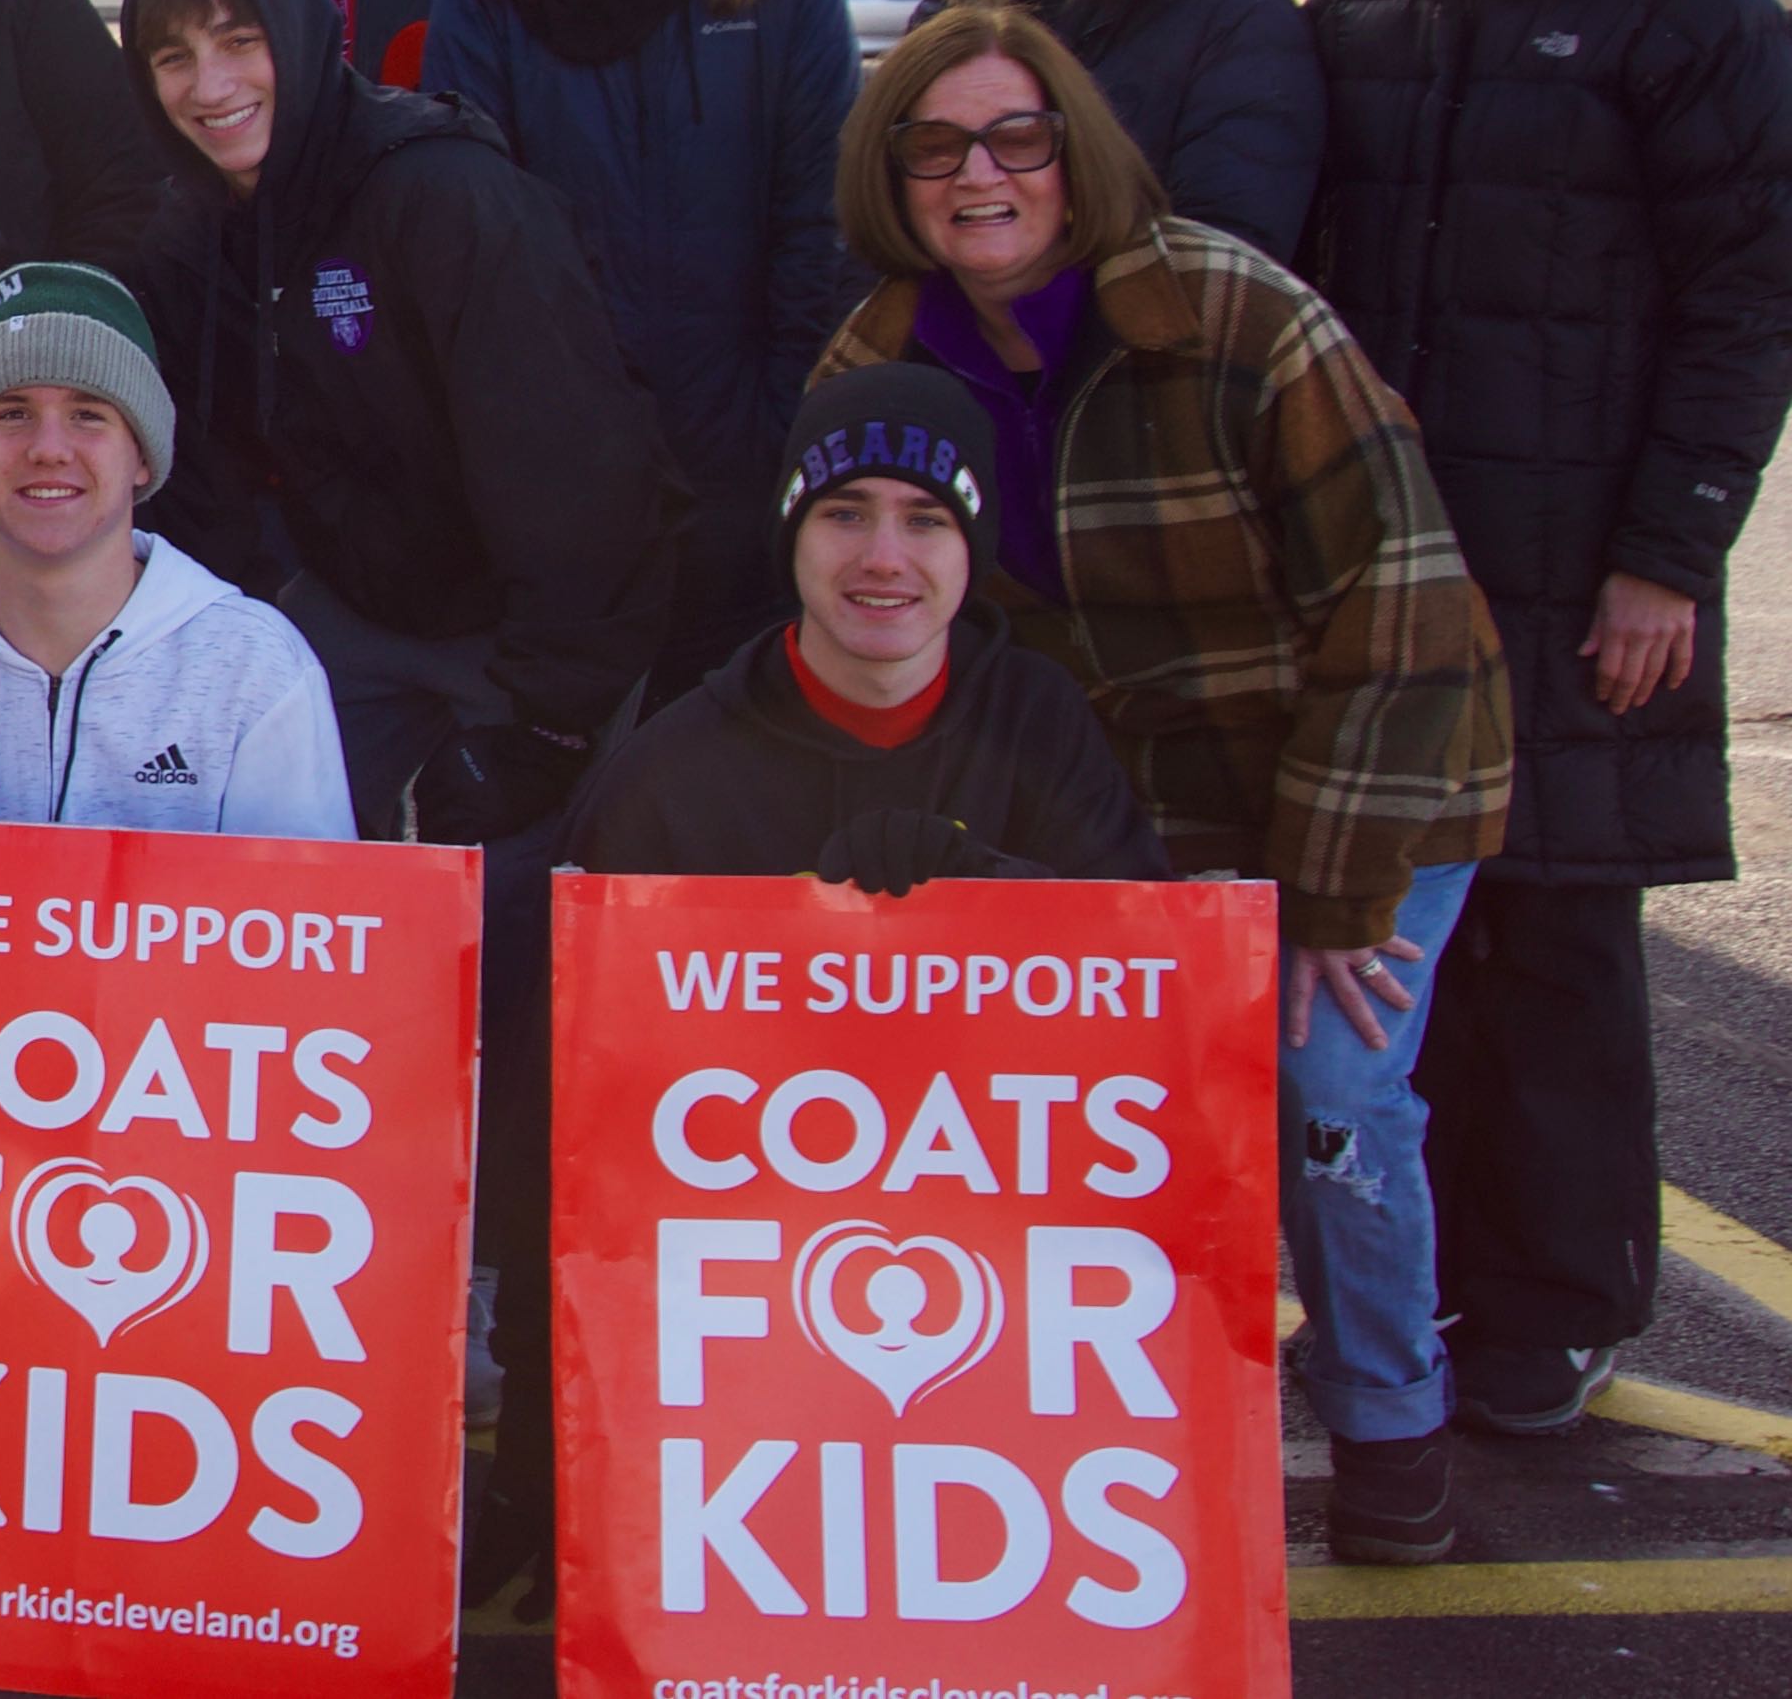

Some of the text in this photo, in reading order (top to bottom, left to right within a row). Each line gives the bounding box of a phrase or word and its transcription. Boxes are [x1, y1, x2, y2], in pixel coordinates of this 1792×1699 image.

[802, 421, 958, 490] BEARS
[135, 768, 199, 785] adidas
[34, 897, 383, 975] SUPPORT
[657, 950, 1178, 1019] WE SUPPORT
[652, 1067, 1172, 1199] COATS
[659, 1438, 1189, 1630] KIDS
